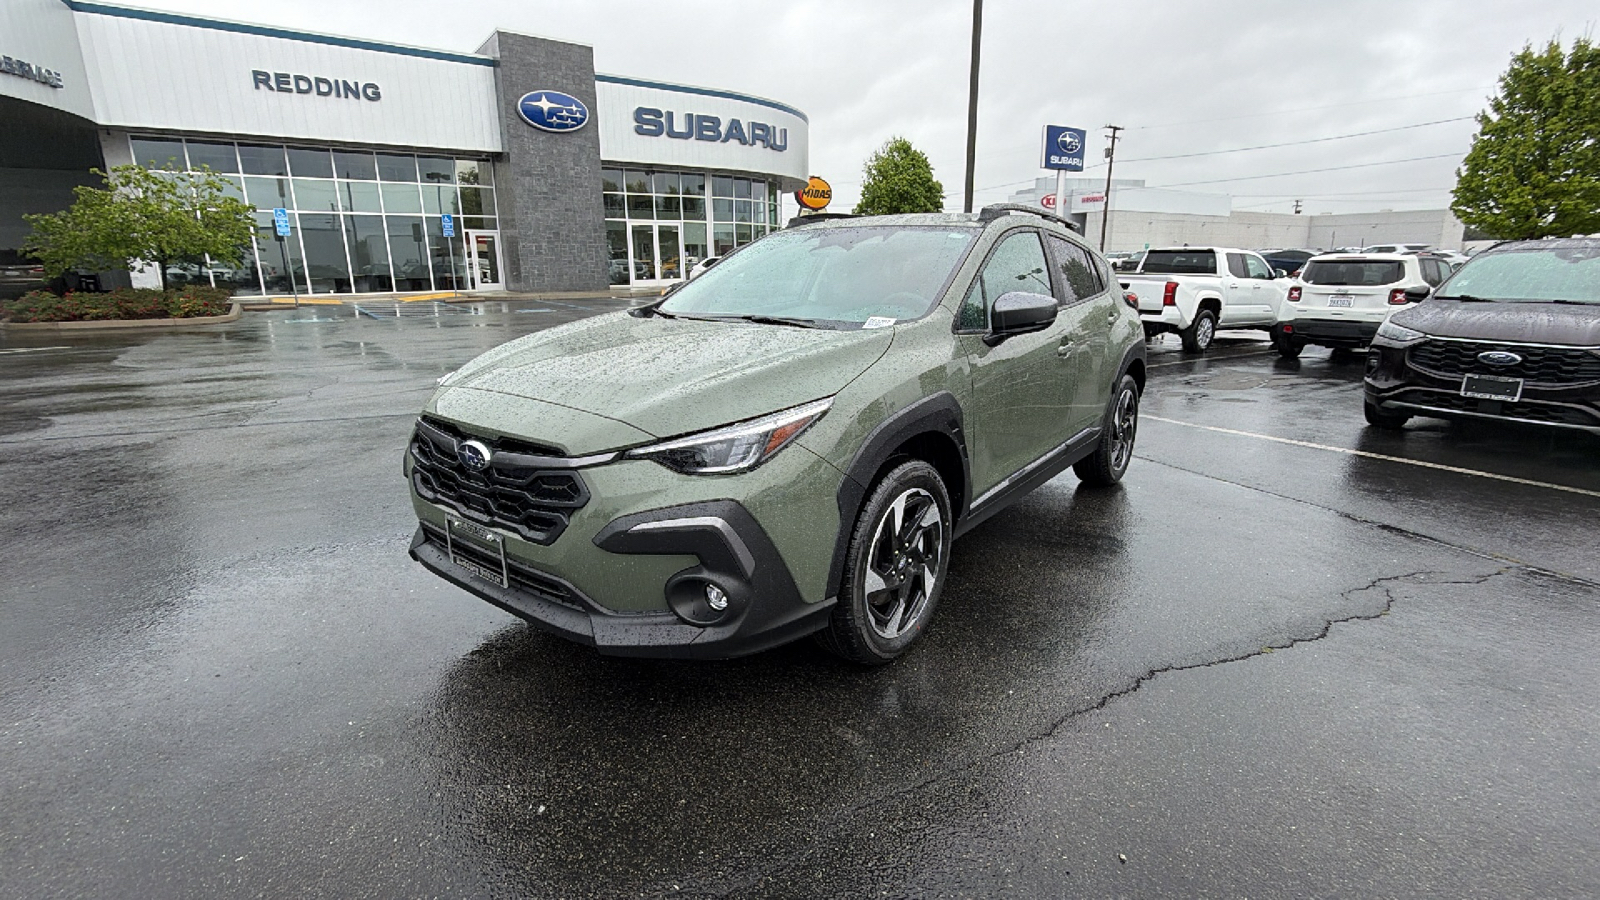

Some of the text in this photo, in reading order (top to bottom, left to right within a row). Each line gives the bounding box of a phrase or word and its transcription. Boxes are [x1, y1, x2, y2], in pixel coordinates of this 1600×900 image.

[0, 54, 64, 89] ERVICE
[251, 69, 382, 102] REDDING
[633, 106, 788, 152] SUBARU
[1050, 155, 1083, 166] SUBARU
[802, 187, 831, 199] MIDAS
